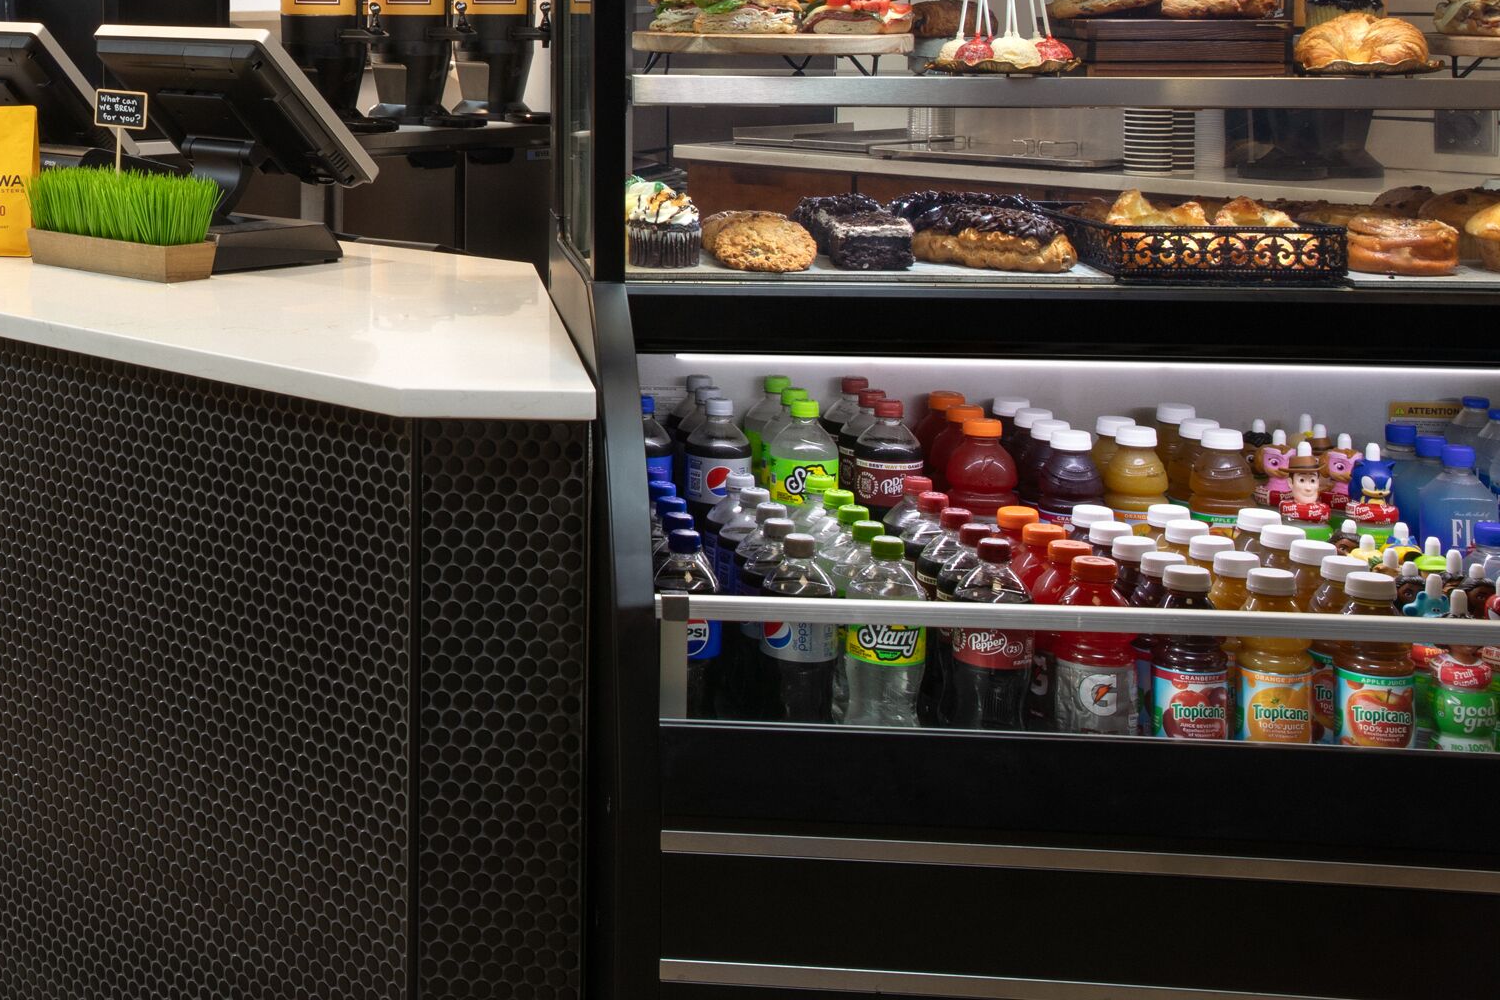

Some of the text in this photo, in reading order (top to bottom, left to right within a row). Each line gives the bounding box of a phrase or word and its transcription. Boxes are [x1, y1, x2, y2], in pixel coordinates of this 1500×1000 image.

[100, 95, 137, 106] What can
[114, 104, 136, 113] BREW
[103, 113, 141, 124] for you?
[858, 624, 919, 657] Starry
[971, 633, 1005, 652] Pepper
[980, 632, 996, 642] Dr
[1254, 674, 1285, 683] ORANGE
[1453, 668, 1475, 680] Fruit
[1360, 677, 1385, 685] APPLE
[1078, 674, 1118, 716] G
[1171, 703, 1225, 722] Tropicana
[1252, 703, 1309, 723] Tropicana
[1351, 705, 1411, 725] Tropicana
[1453, 697, 1496, 723] good
[1258, 721, 1305, 731] 100% JUICE
[1357, 724, 1407, 734] 100% JUICE
